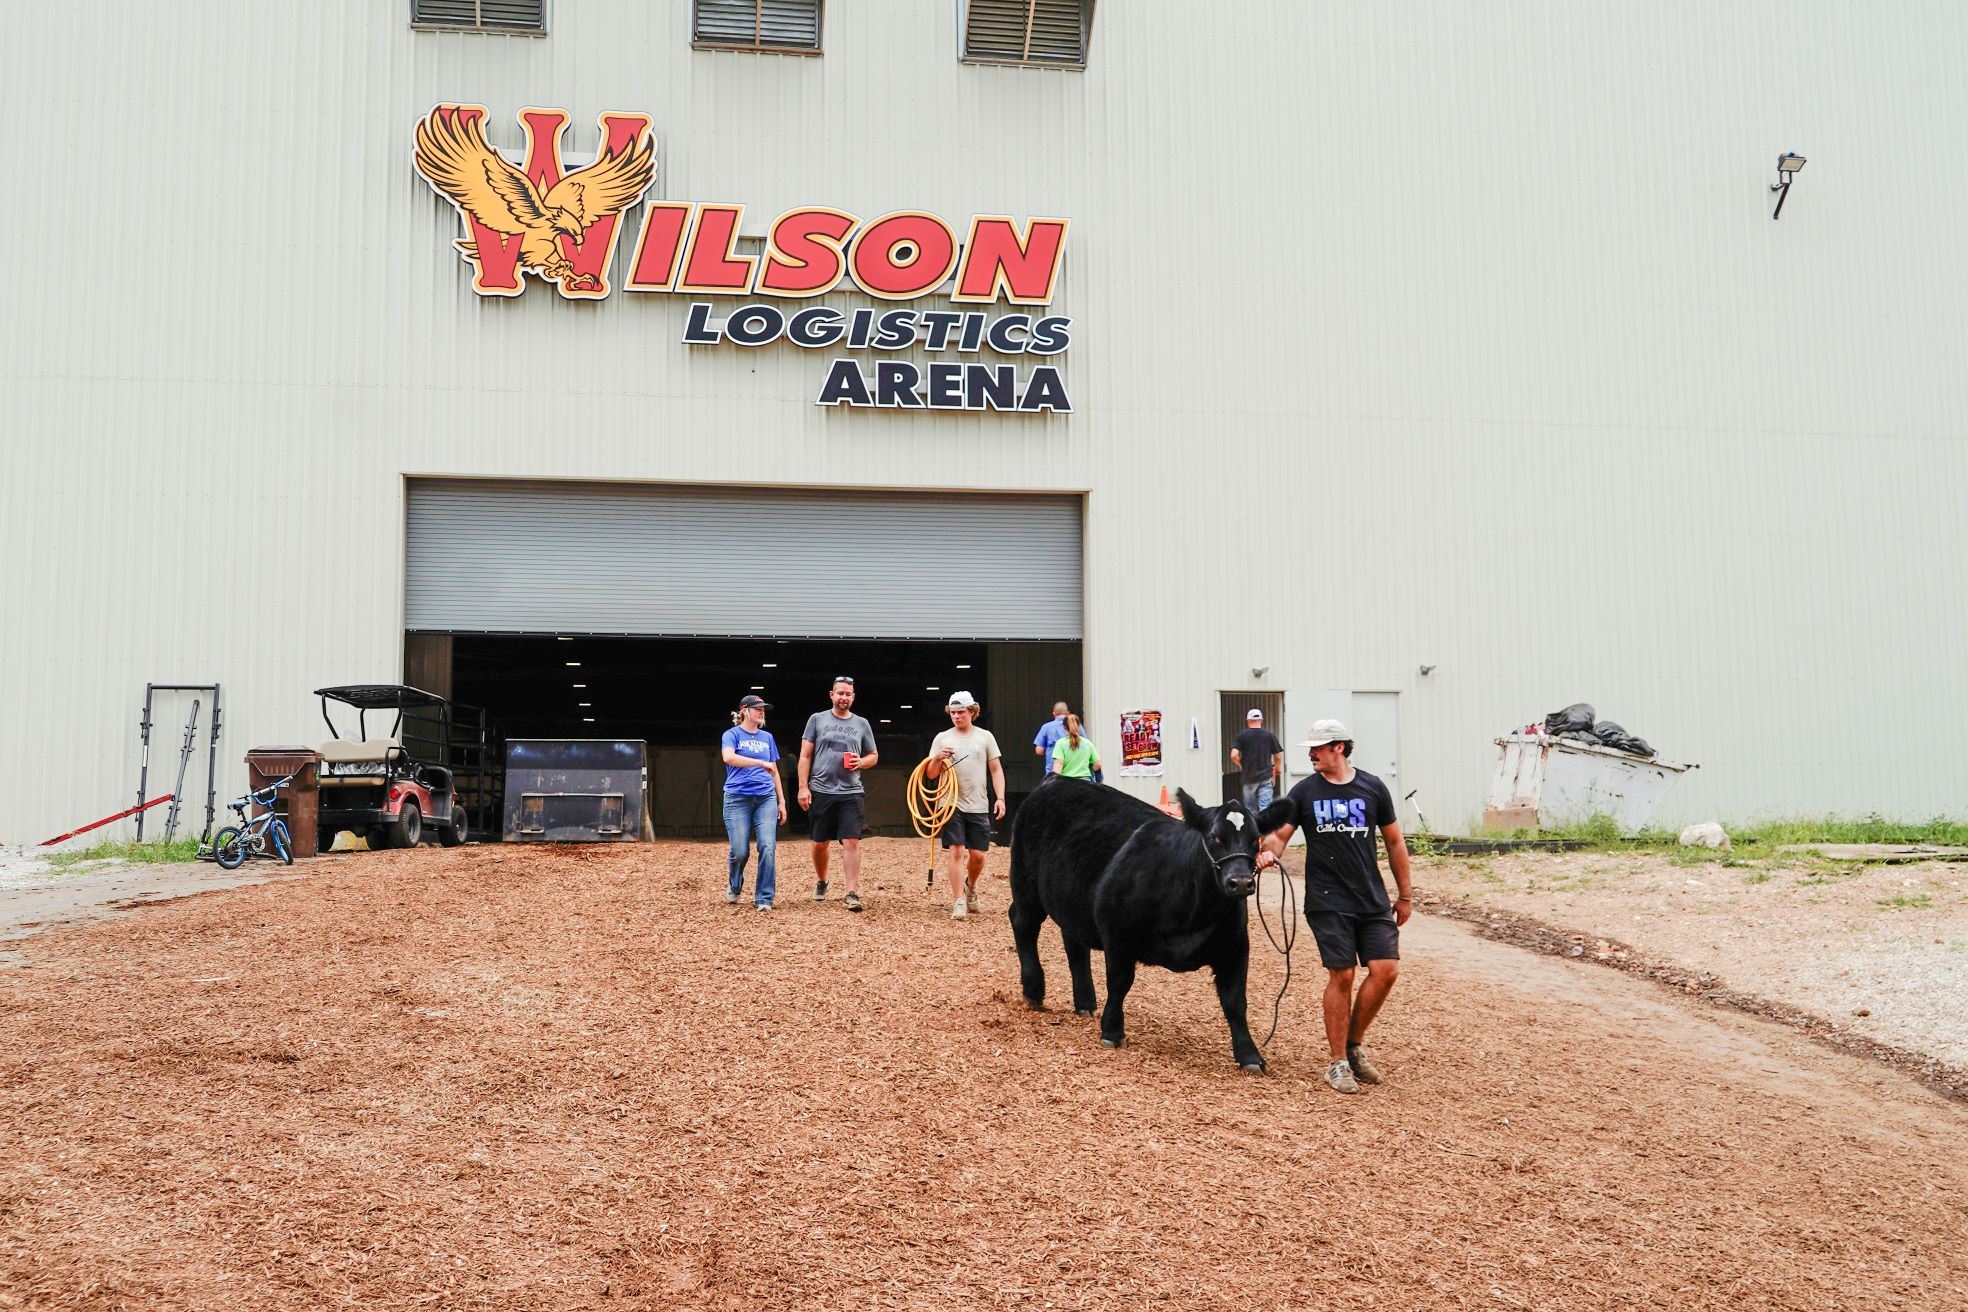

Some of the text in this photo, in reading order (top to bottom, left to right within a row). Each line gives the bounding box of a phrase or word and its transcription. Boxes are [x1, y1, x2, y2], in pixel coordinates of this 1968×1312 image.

[412, 102, 1072, 306] WILSON
[682, 302, 1073, 355] LOGISTICS
[815, 357, 1074, 414] ARENA
[1124, 730, 1151, 742] READY
[1125, 741, 1139, 752] SET
